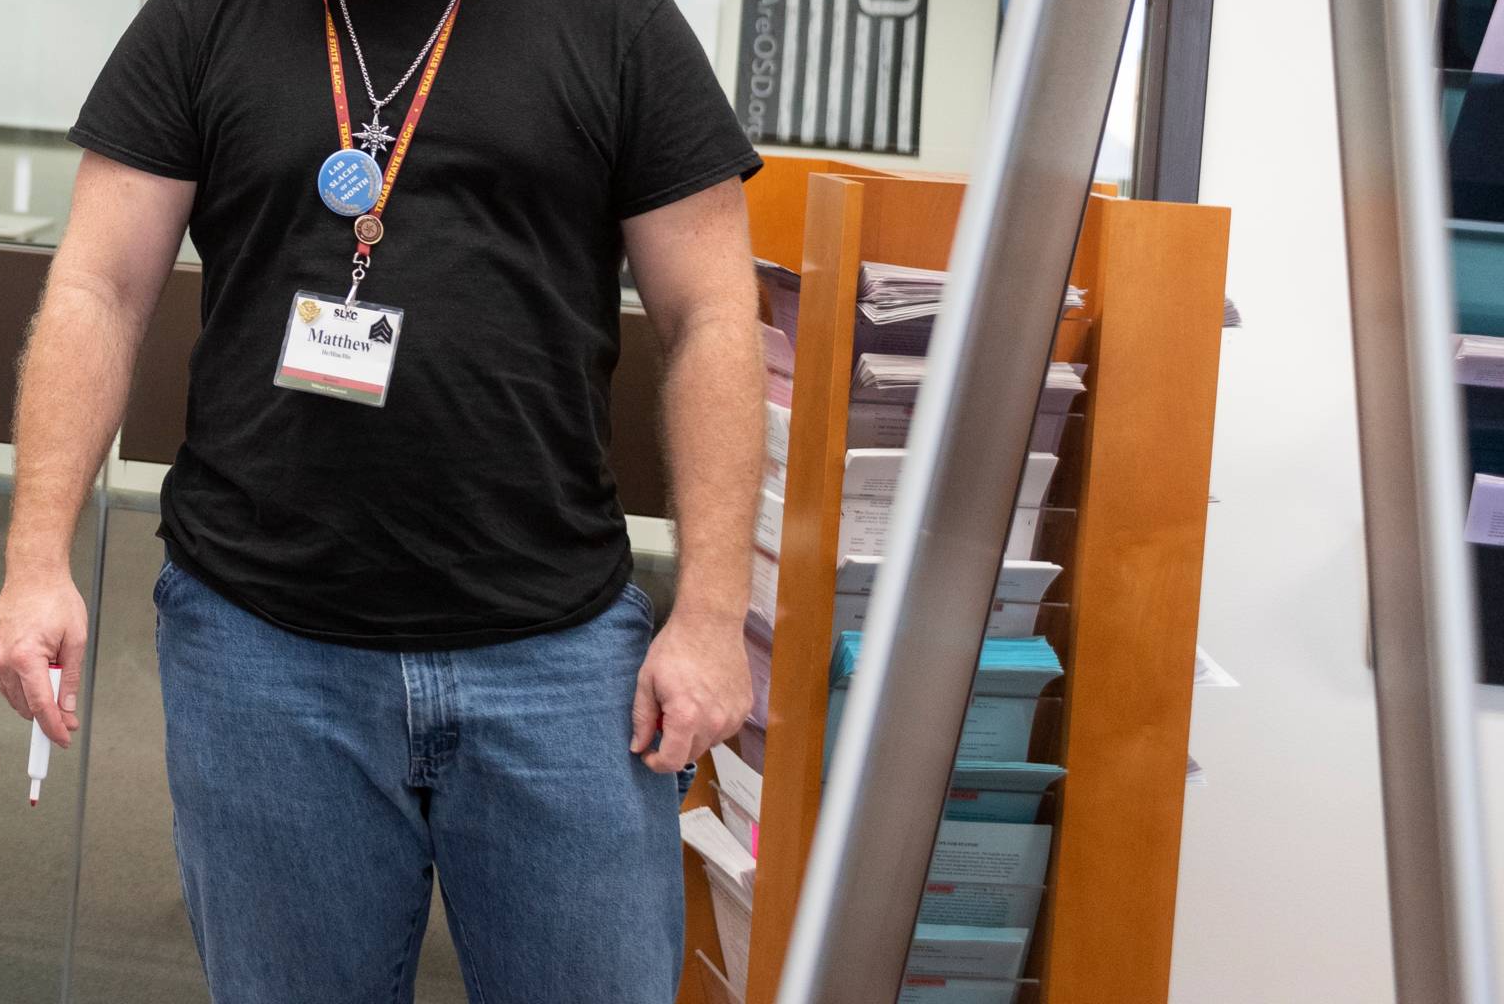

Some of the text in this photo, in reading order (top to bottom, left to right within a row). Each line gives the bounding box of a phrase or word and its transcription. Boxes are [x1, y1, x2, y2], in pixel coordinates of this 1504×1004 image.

[329, 37, 338, 62] STATE
[419, 69, 435, 96] TEXAS
[430, 43, 445, 69] STATE
[328, 160, 345, 176] LAB
[329, 163, 359, 188] SLACER
[375, 122, 414, 212] TEXAS STATE SLACer
[340, 177, 369, 202] MONTH
[308, 327, 373, 353] Matthew
